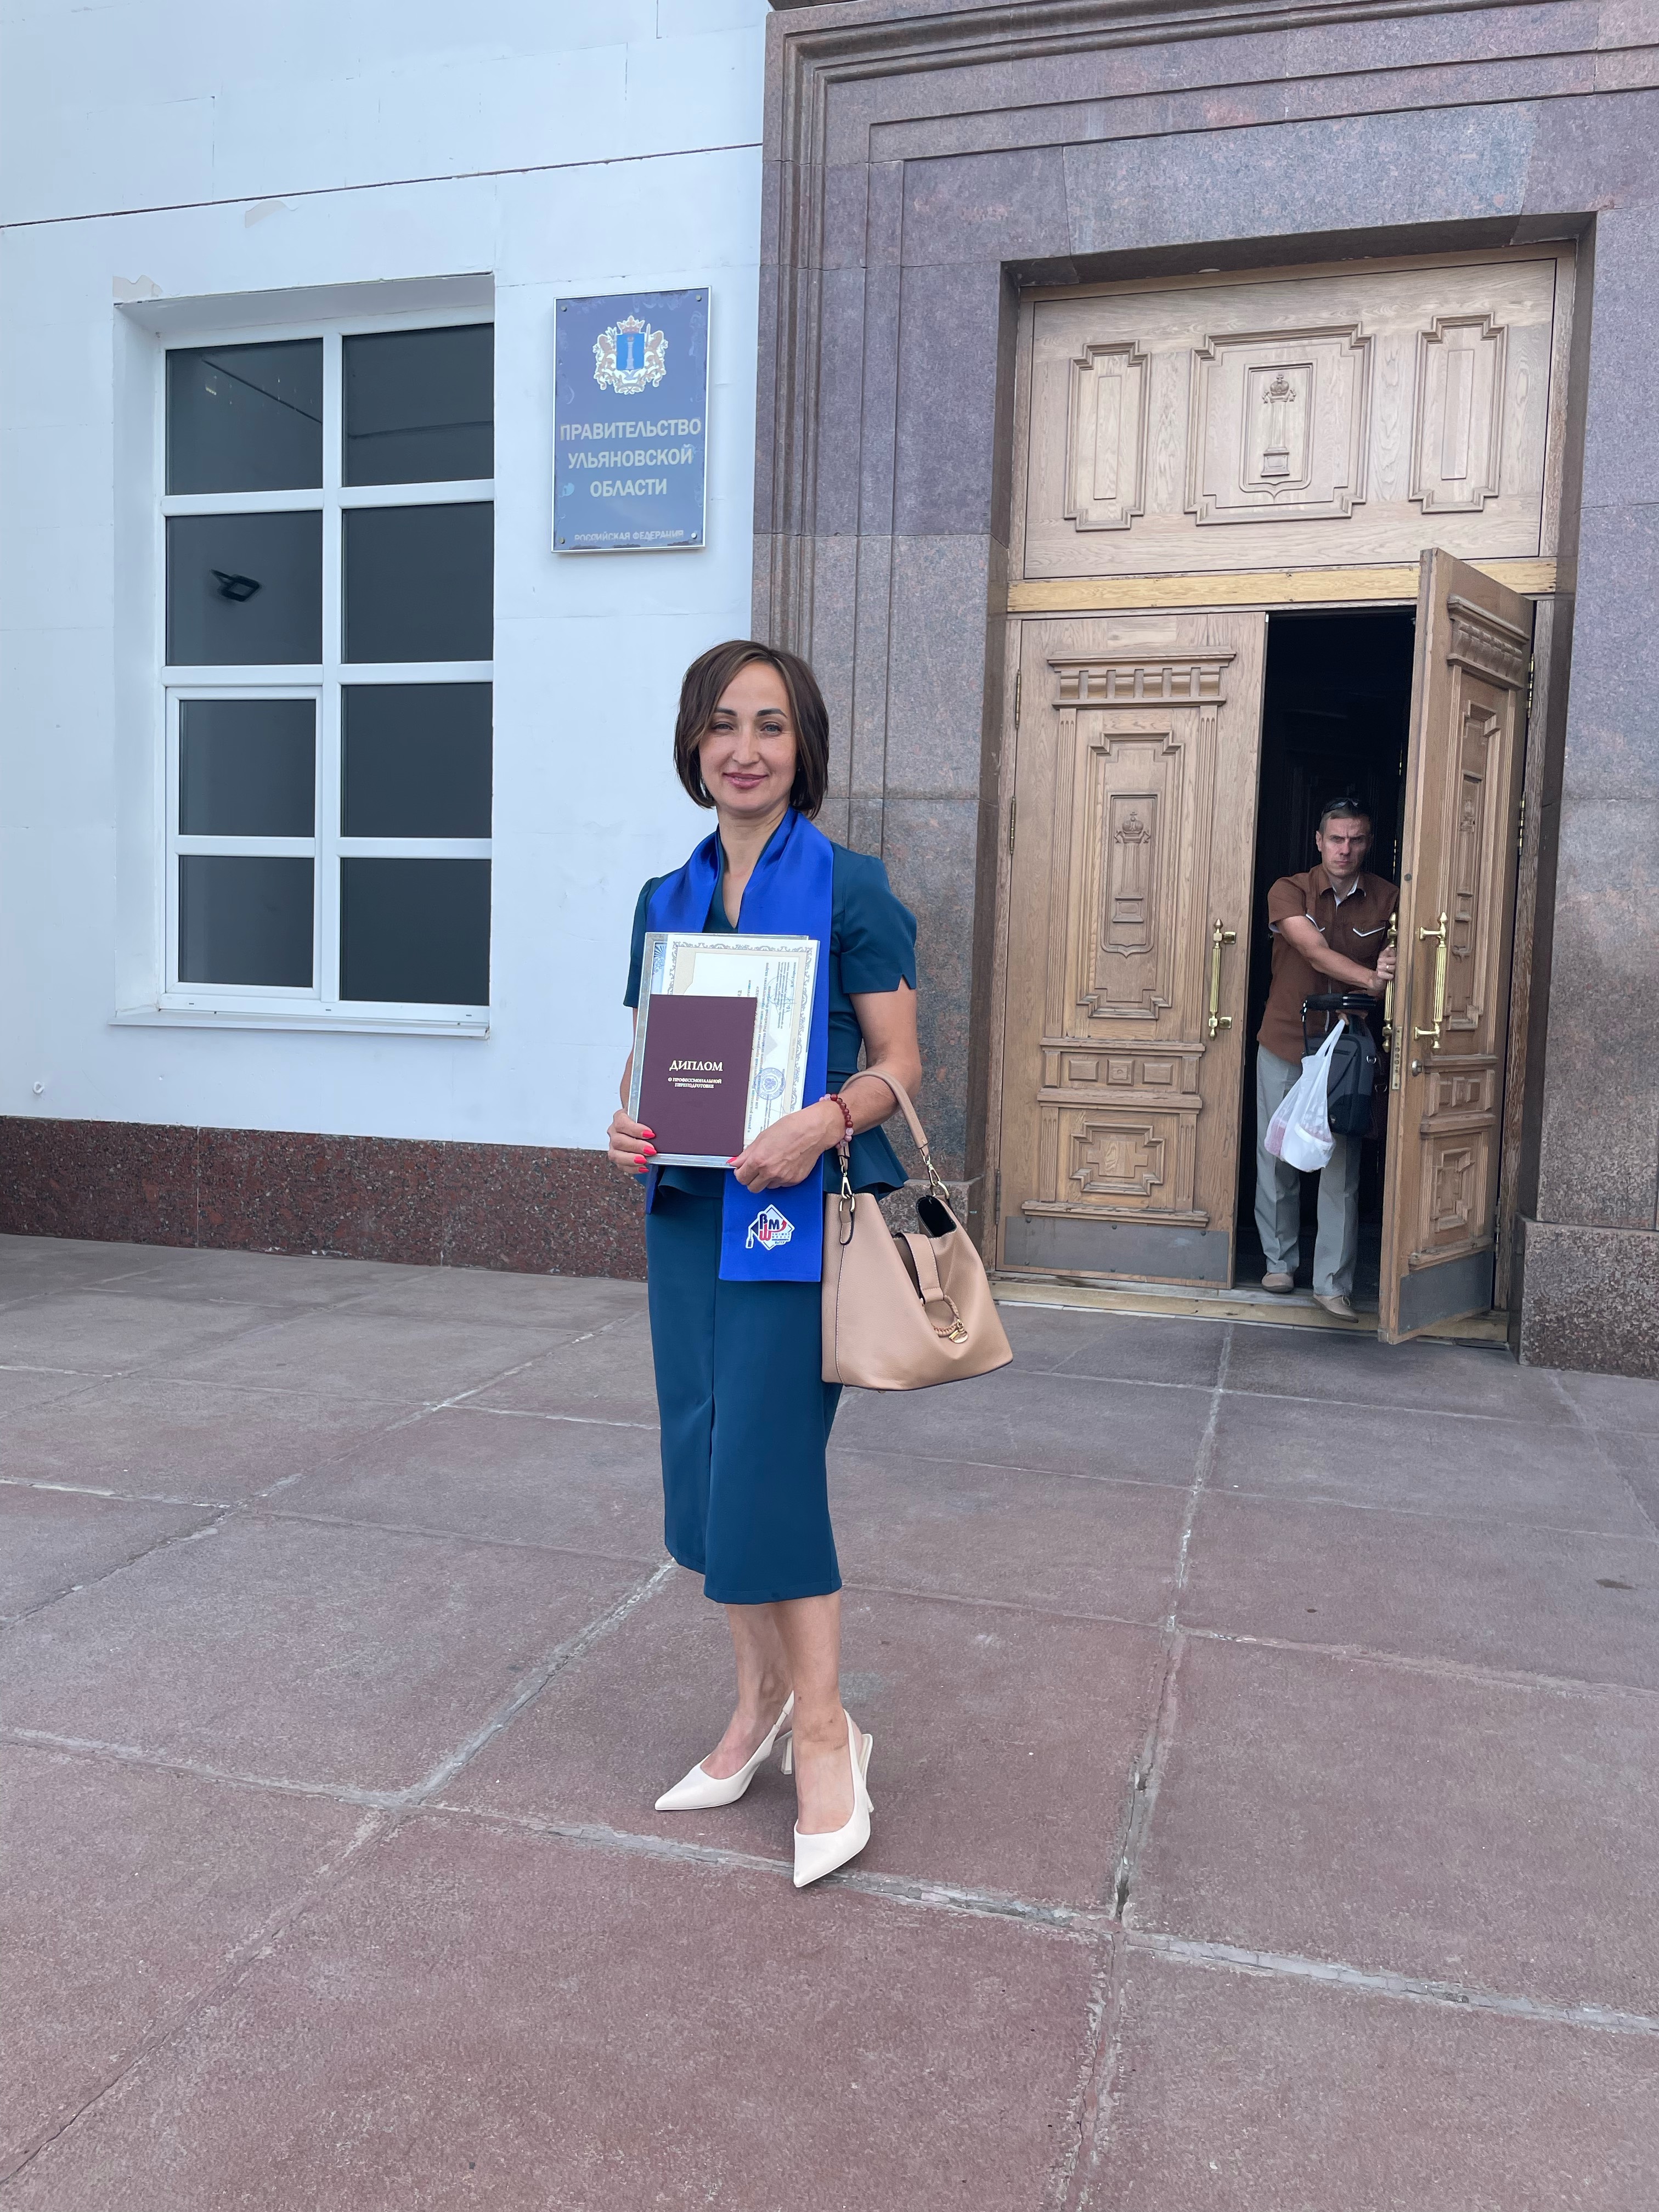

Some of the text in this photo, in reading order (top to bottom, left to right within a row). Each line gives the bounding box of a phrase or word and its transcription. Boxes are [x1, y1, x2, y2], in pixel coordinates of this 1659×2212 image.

[560, 417, 701, 441] ПРАВИТЕЛЬСТВО
[568, 443, 692, 469] УЛЬЯНОВСКОЙ
[590, 478, 667, 498] ОБЛАСТИ
[574, 529, 684, 541] РОССИЙСКАЯ ФЕДЕРАЦИЯ
[669, 1060, 723, 1071] ДИПЛОМ
